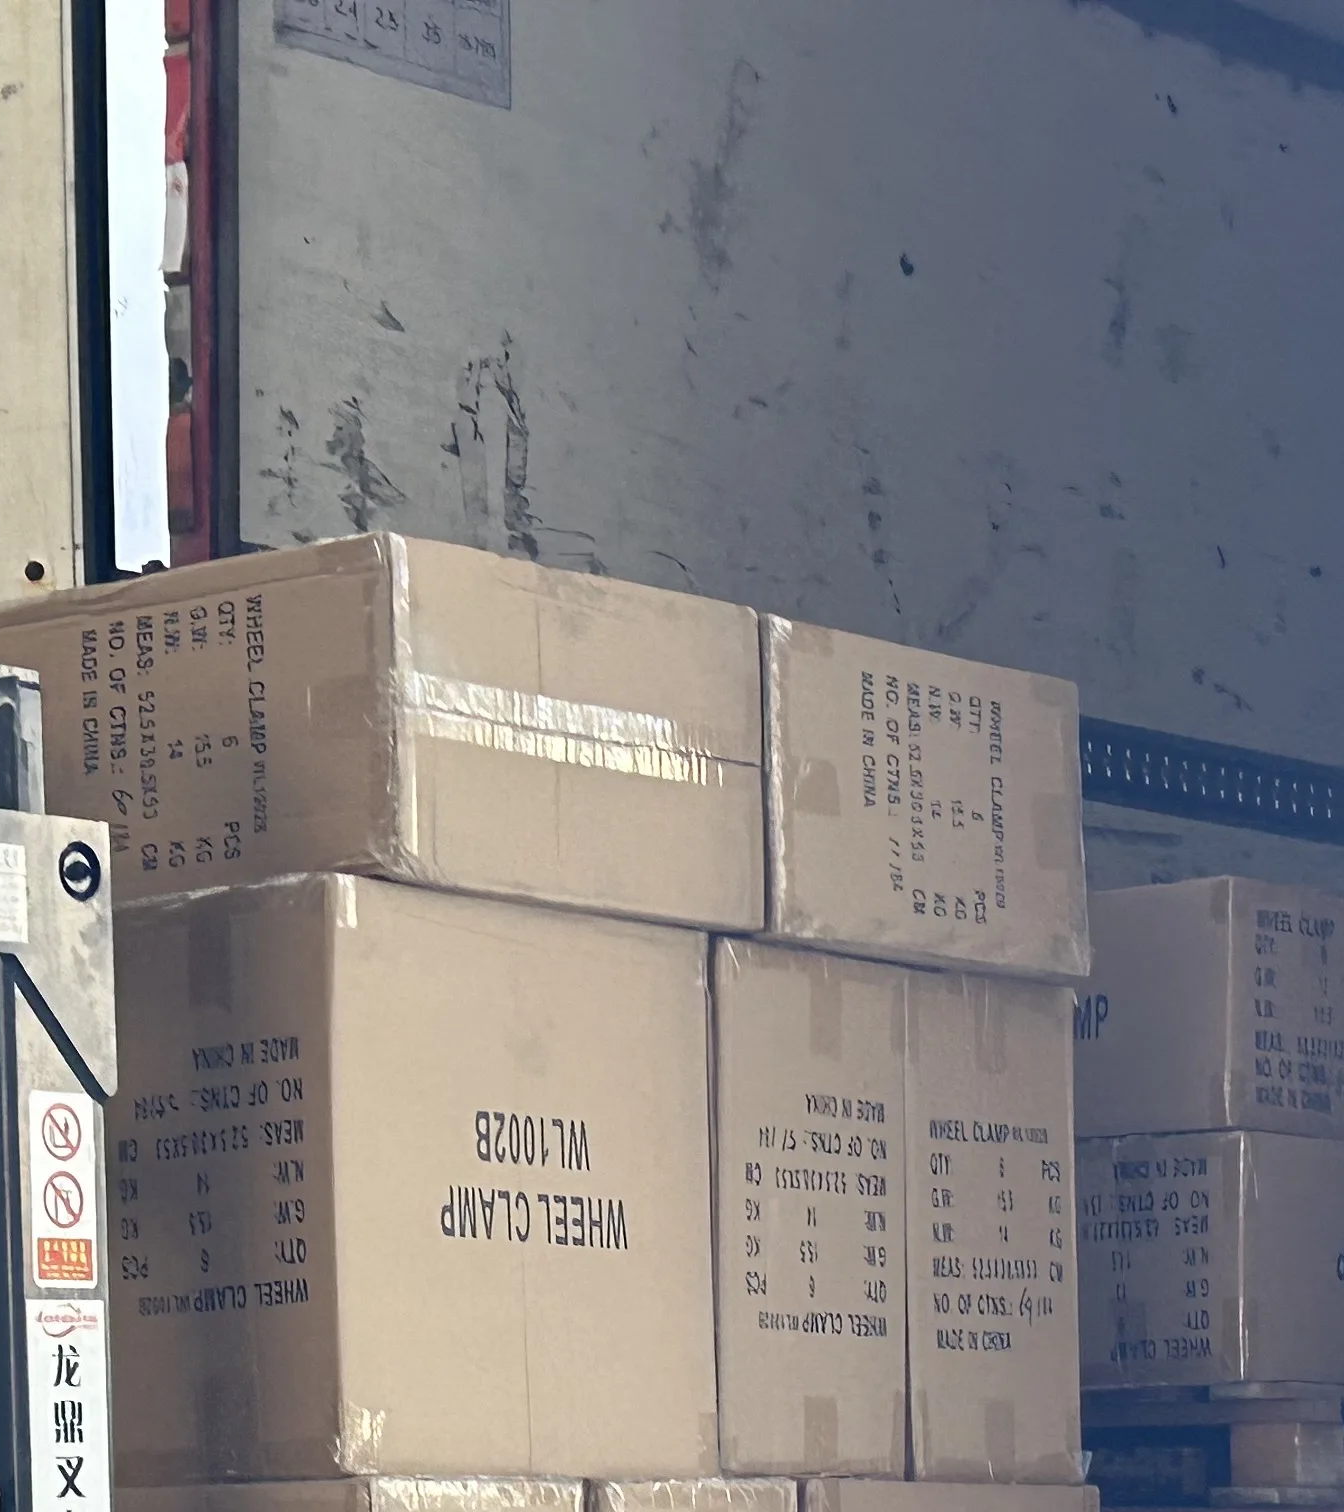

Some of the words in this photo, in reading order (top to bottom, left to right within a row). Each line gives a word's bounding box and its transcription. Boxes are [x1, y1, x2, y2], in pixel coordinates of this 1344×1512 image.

[217, 601, 236, 646] QTY:
[246, 595, 265, 672] WHEEL
[81, 629, 99, 682] MADE
[109, 668, 127, 694] OF
[83, 691, 98, 709] IN
[248, 680, 267, 754] CLAMP
[222, 736, 239, 748] 6
[886, 720, 900, 744] OF
[81, 718, 100, 776] CHINA
[862, 755, 876, 808] CHINA
[990, 776, 1005, 842] CLAMP
[168, 841, 187, 868] KG
[195, 837, 213, 863] KG
[223, 822, 241, 861] PCS
[241, 1043, 254, 1065] IN
[260, 1037, 300, 1062] MADE
[248, 1081, 268, 1106] OF
[276, 1078, 303, 1103] NO.
[475, 1111, 590, 1172] WL1002B
[440, 1185, 530, 1243] CLAMP
[537, 1194, 628, 1250] WHEEL
[193, 1286, 246, 1313] CLAMP
[254, 1279, 309, 1306] WHEEL
